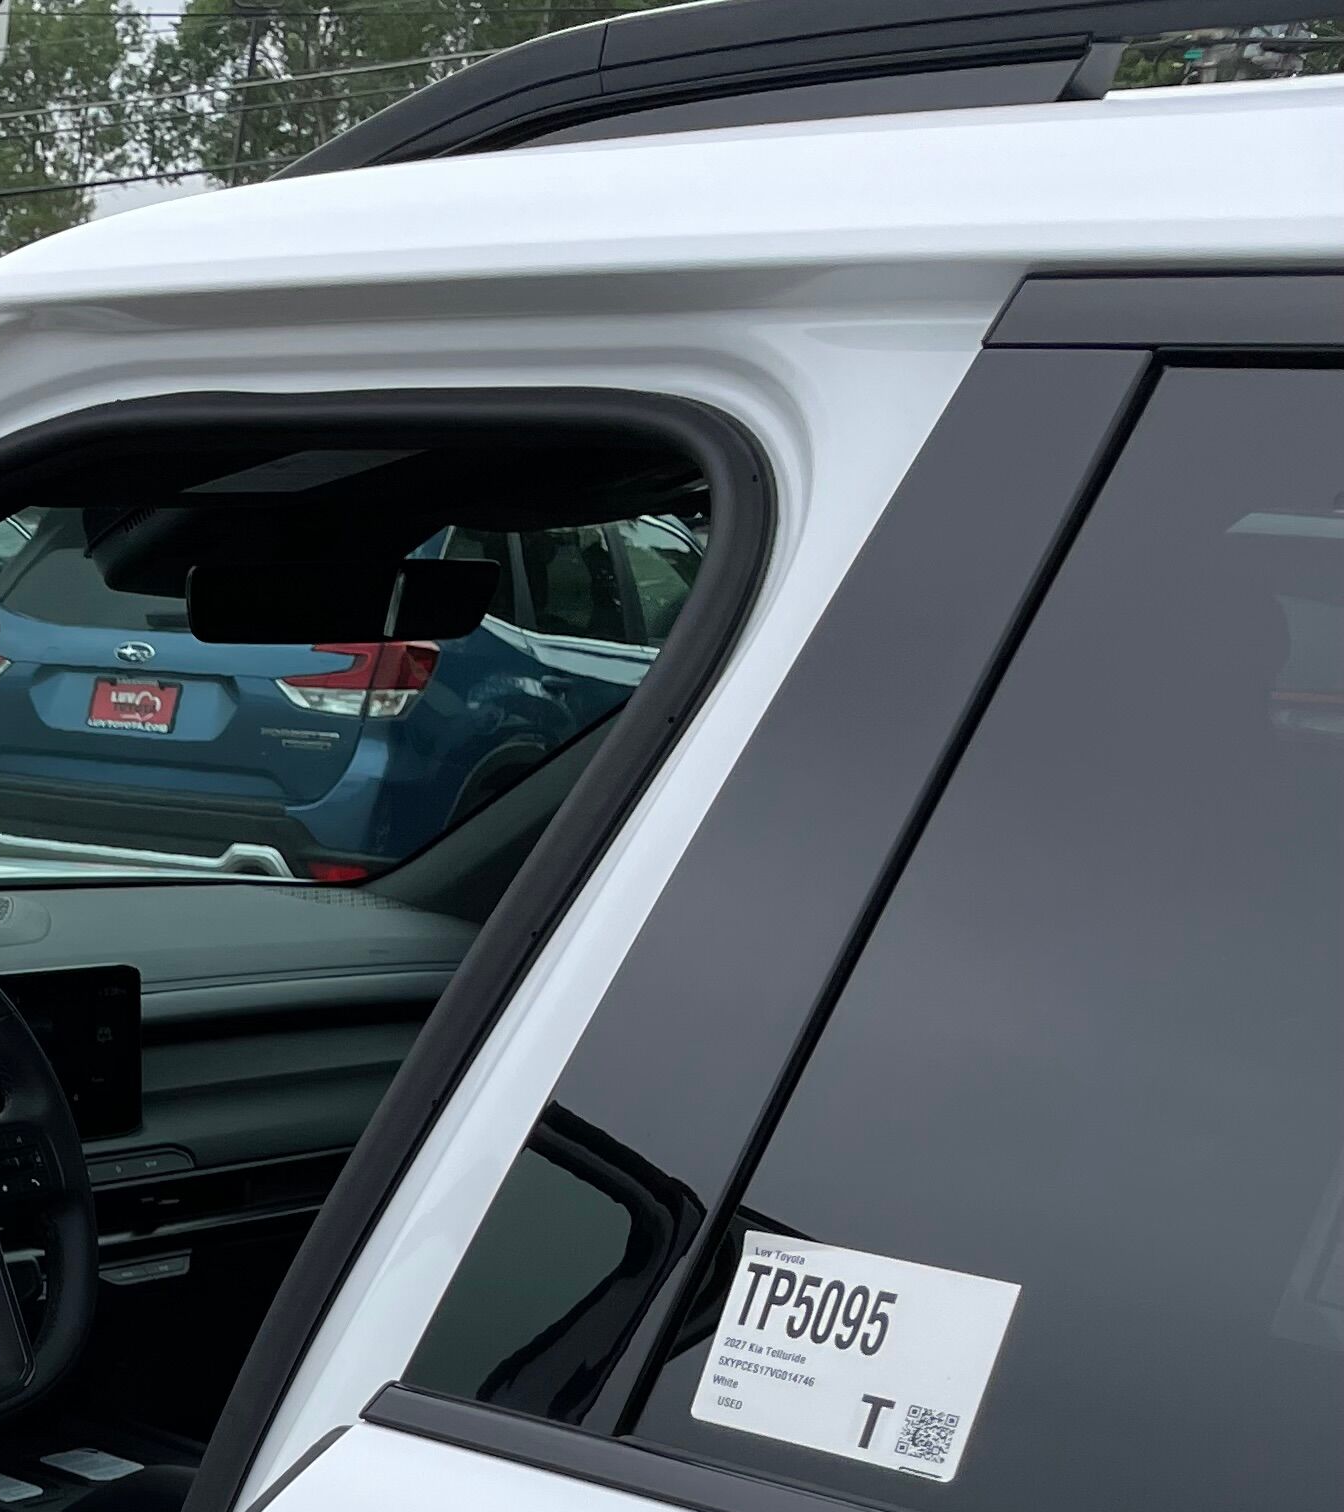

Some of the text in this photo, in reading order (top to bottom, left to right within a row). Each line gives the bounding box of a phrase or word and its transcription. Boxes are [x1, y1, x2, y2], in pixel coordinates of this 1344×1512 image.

[775, 1250, 806, 1265] Toyota
[738, 1262, 899, 1356] TP5095
[723, 1337, 807, 1365] 2027 Kia Telluride
[712, 1373, 739, 1389] White
[717, 1396, 743, 1410] USED
[857, 1394, 896, 1449] T
